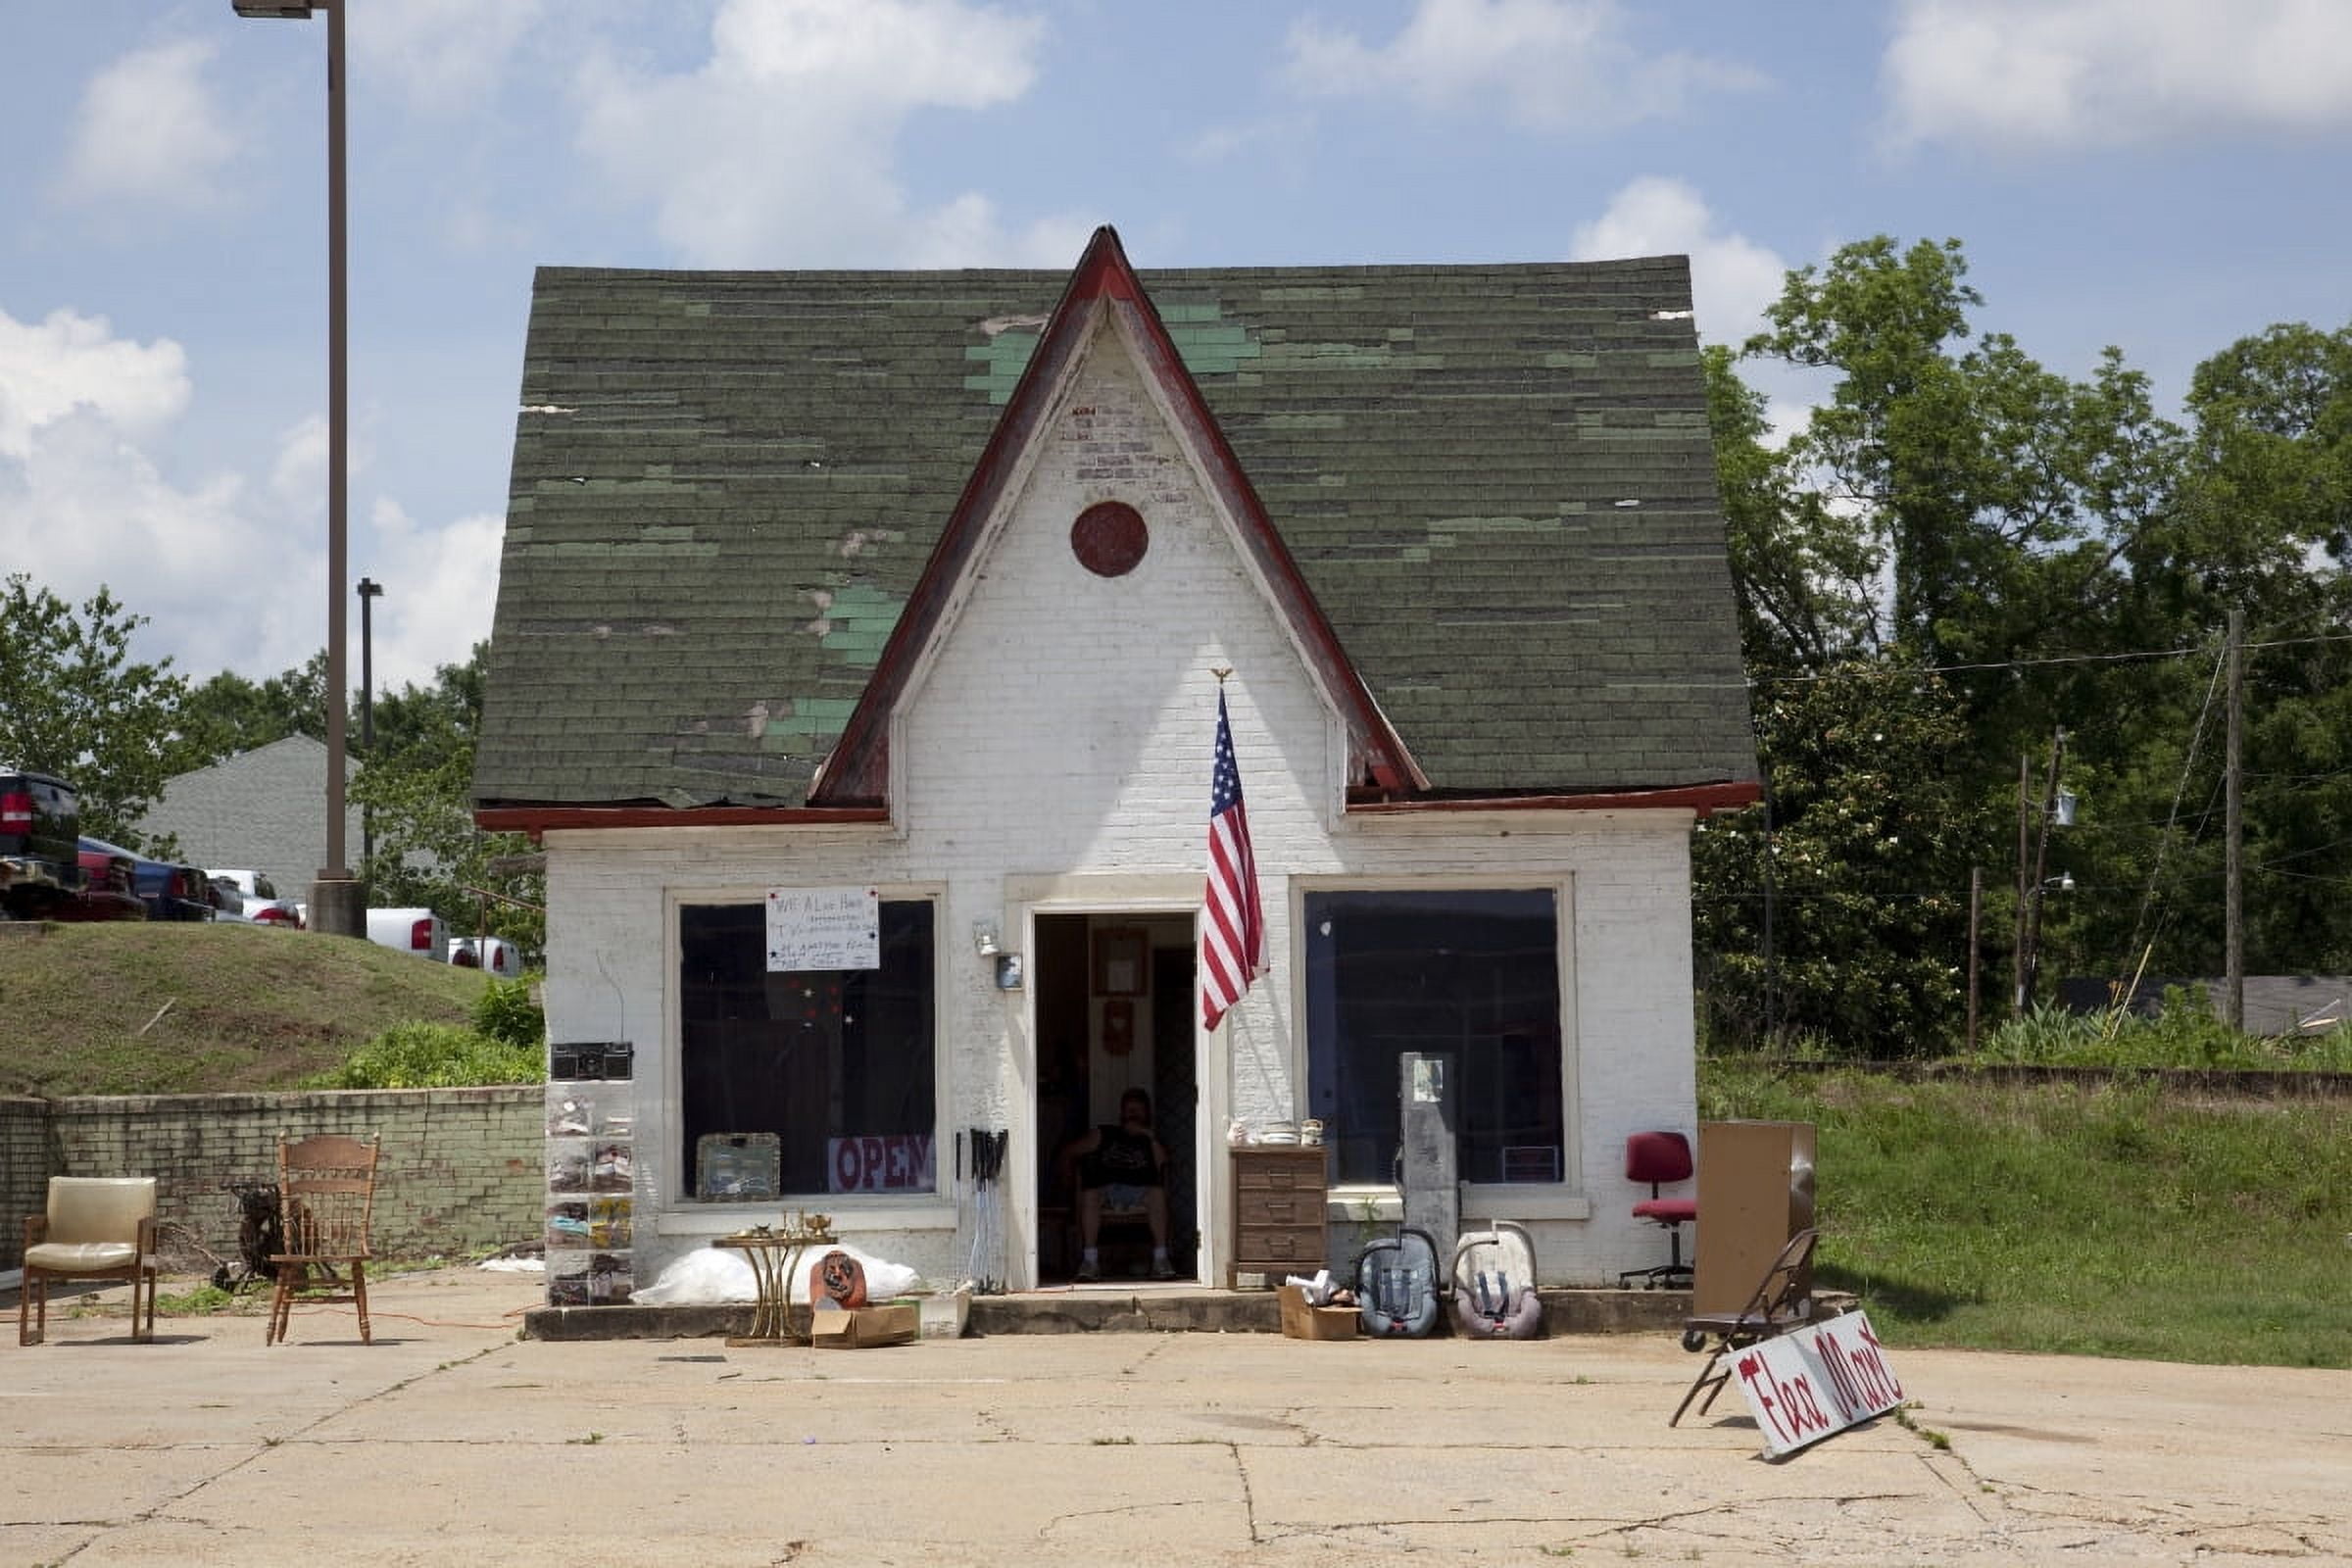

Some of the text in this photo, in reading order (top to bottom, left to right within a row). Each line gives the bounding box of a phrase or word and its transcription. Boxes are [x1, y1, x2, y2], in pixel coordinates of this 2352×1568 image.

[837, 1135, 930, 1191] OPEN
[1738, 1317, 1904, 1444] Flea Mart
